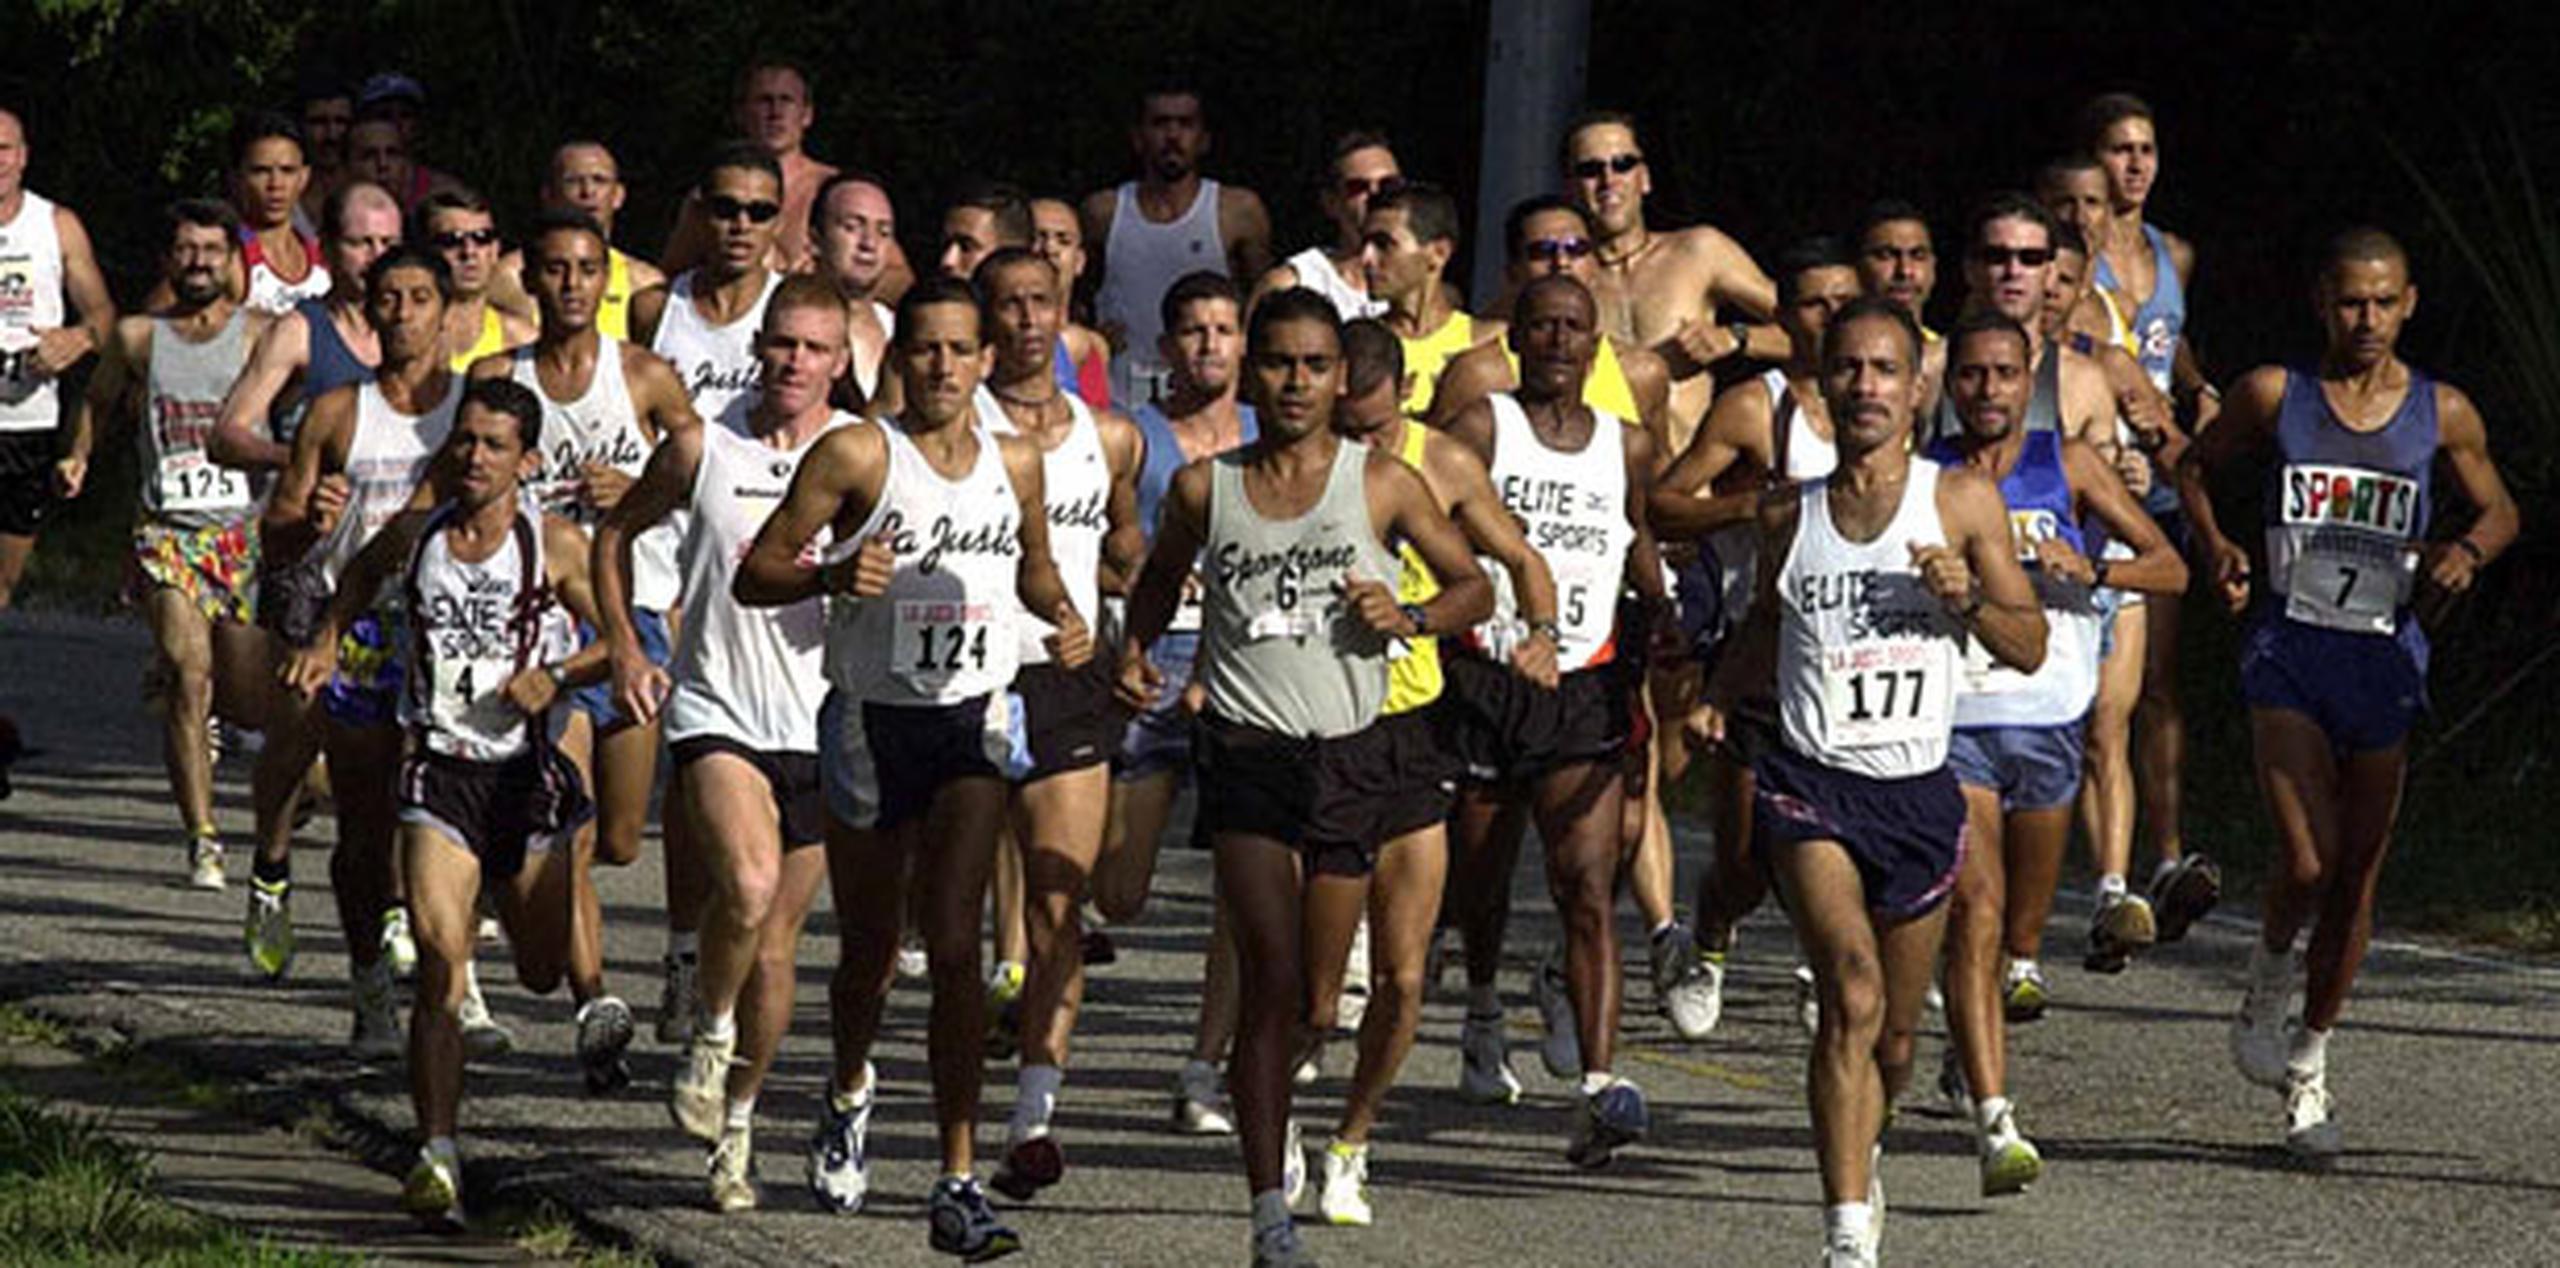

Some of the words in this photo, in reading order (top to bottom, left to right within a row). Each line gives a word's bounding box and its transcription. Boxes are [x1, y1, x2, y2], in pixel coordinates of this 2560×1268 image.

[1503, 475, 1576, 516] ELITE
[2290, 472, 2411, 532] SPORTS
[1537, 521, 1608, 556] SPORTS
[1277, 563, 1298, 611] 6
[1801, 569, 1878, 614] ELITE
[2336, 566, 2358, 608] 7
[915, 624, 988, 670] 124
[455, 664, 474, 705] 4
[1848, 670, 1925, 721] 177
